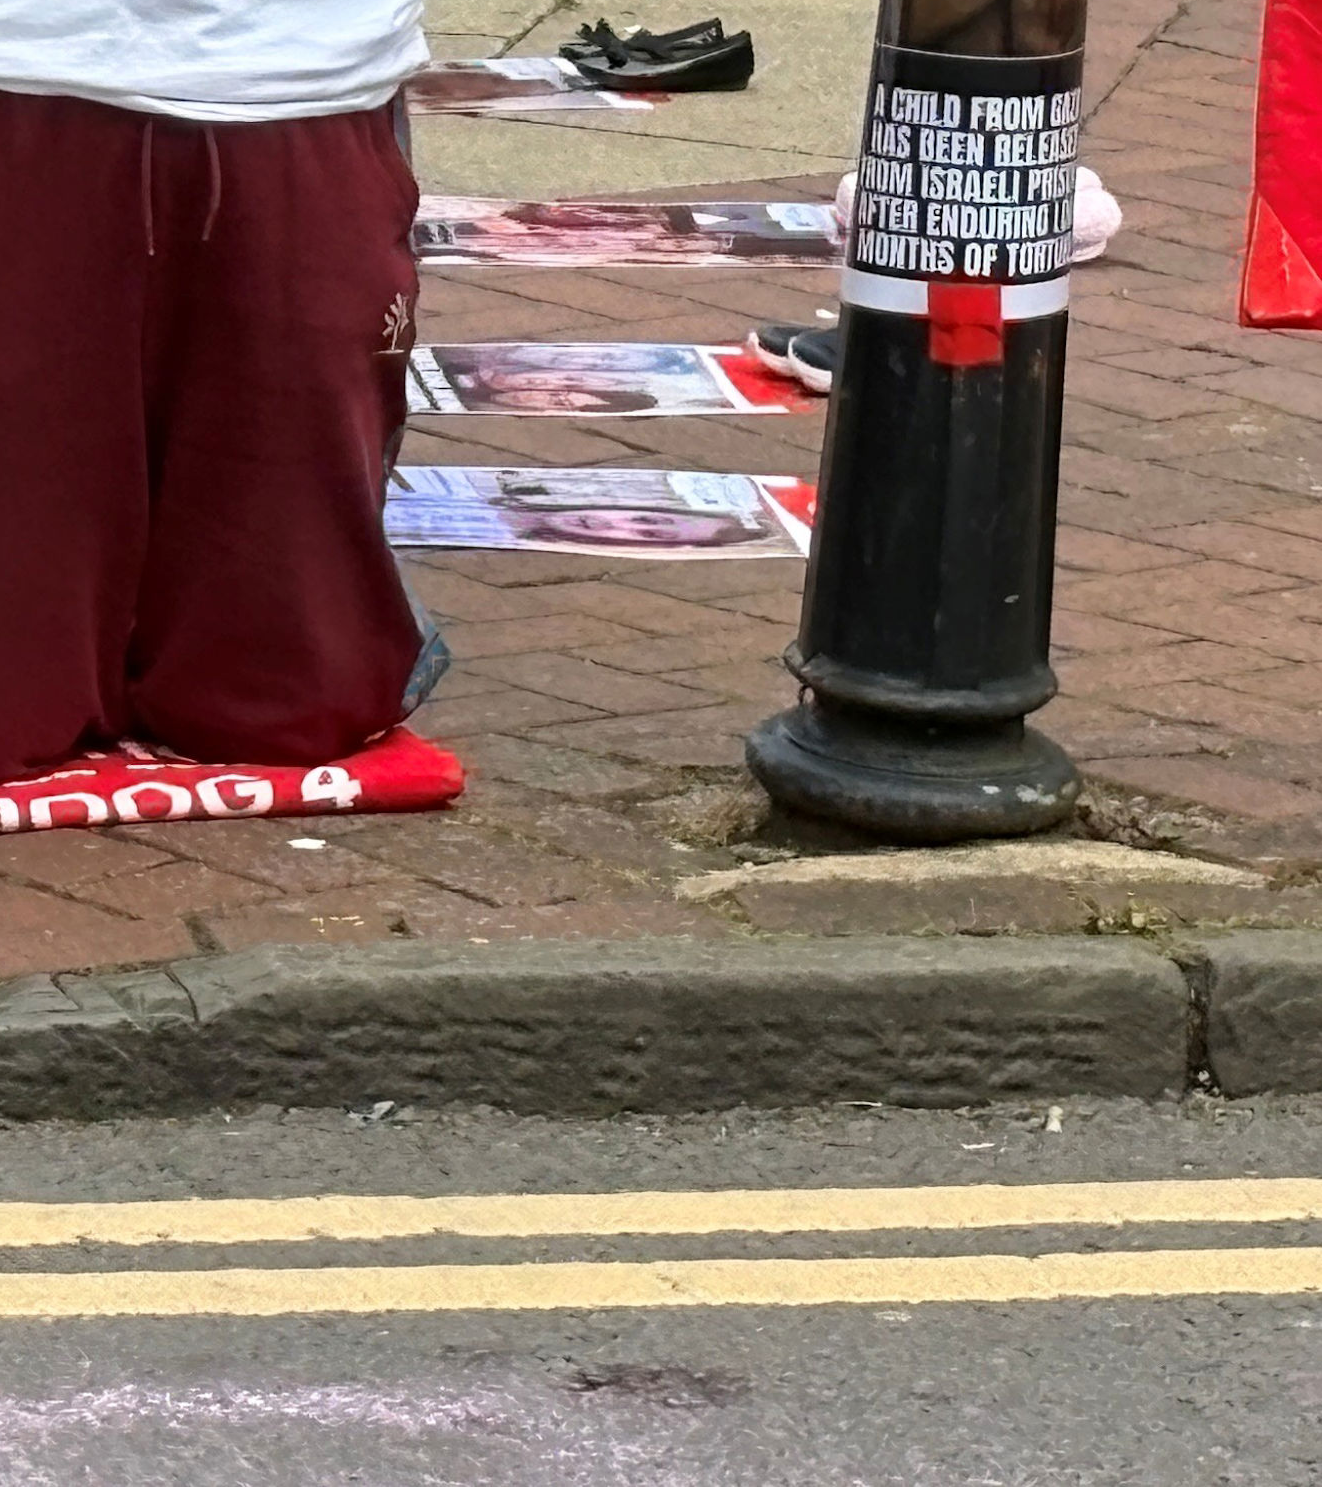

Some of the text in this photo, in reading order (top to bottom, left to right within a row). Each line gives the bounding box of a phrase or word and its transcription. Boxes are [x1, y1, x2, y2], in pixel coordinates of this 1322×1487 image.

[874, 83, 885, 117] A
[891, 87, 961, 130] CHILD
[970, 94, 1045, 131] FROM
[871, 119, 912, 159] HAS
[919, 129, 985, 167] BEEN
[921, 165, 1020, 205] ISRAELI
[858, 192, 919, 234] AFTER
[926, 202, 1049, 240] ENDURING
[857, 227, 955, 276] MONTHS
[964, 242, 998, 277] OF
[300, 765, 363, 811] 4
